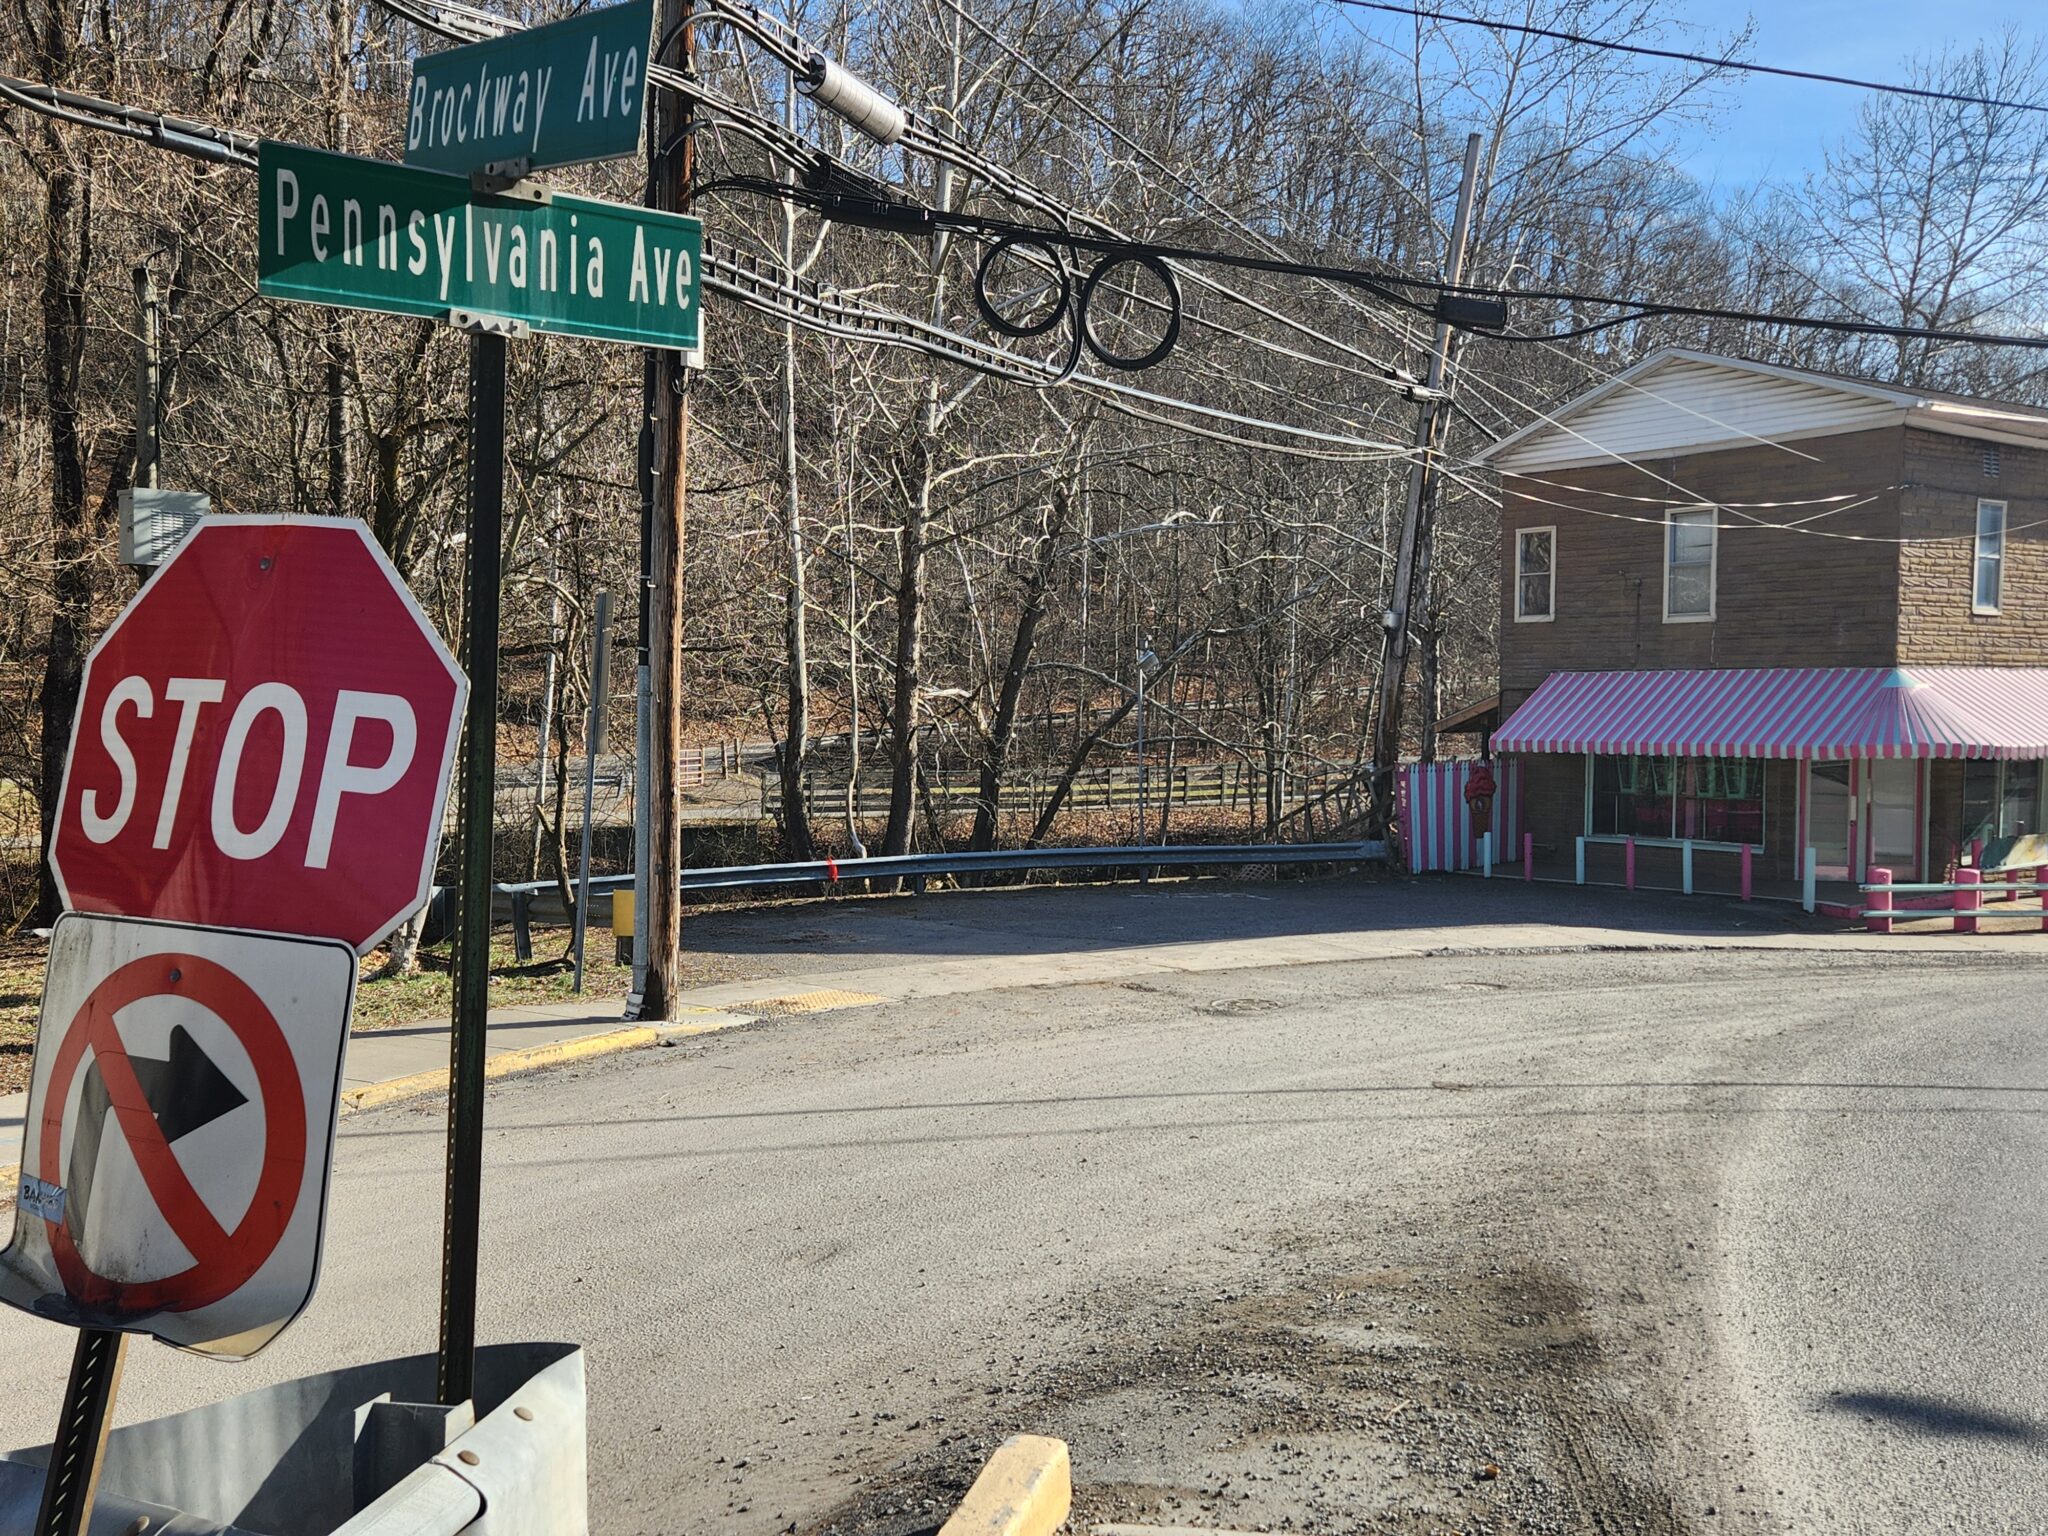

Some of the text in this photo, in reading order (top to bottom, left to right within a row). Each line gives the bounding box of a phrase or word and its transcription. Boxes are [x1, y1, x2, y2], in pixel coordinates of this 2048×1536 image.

[408, 35, 639, 152] Brockway Ave
[276, 168, 692, 310] Pennsylvania Ave
[80, 675, 418, 870] STOP
